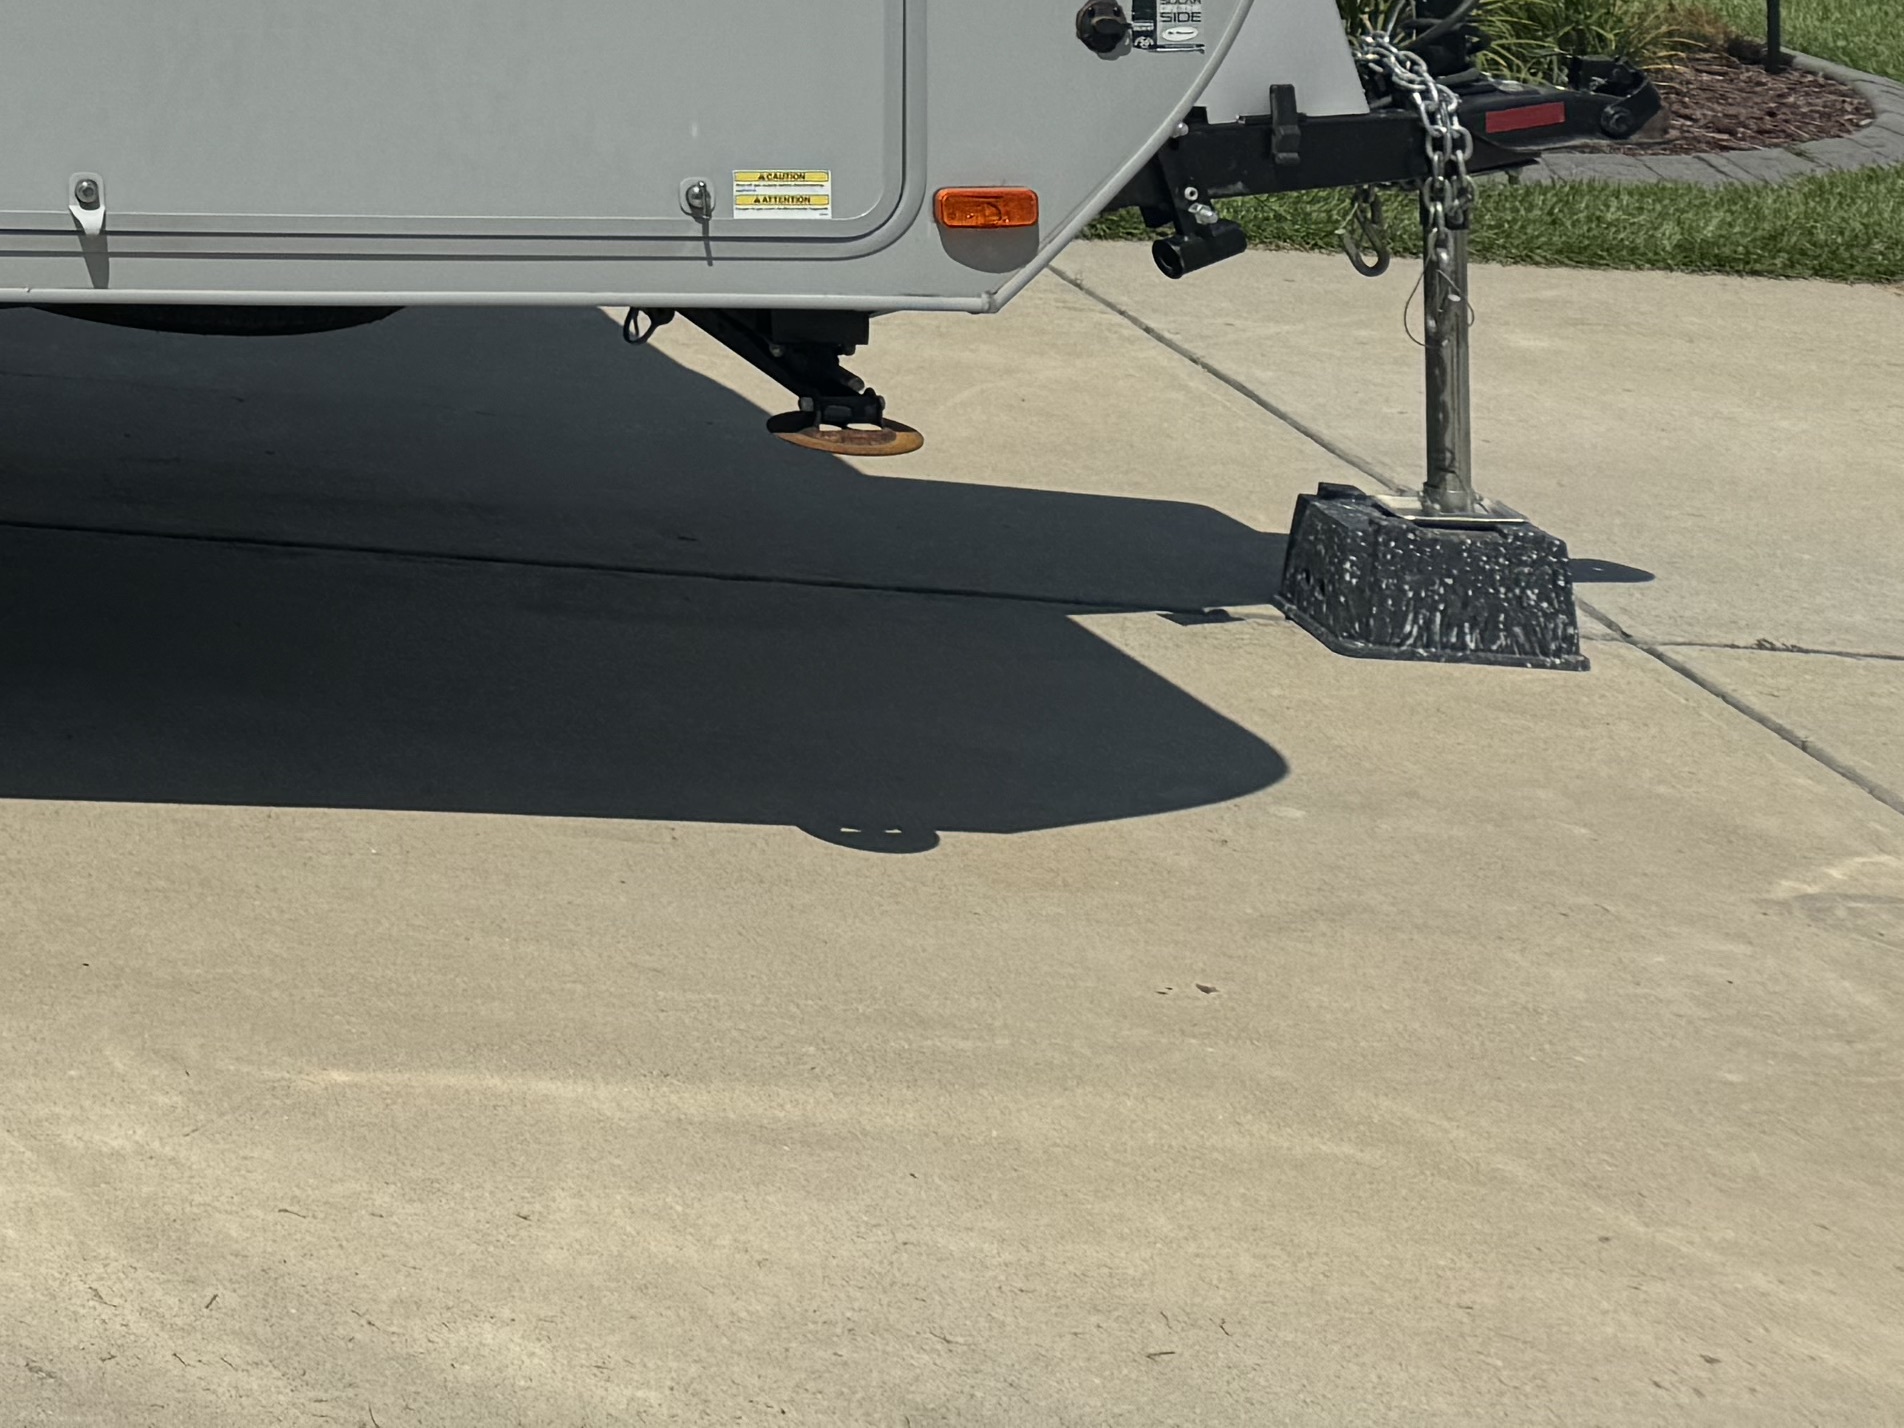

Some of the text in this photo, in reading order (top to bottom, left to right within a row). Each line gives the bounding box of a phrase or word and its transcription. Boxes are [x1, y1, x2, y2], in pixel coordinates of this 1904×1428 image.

[1159, 11, 1202, 23] SIDE
[766, 172, 806, 180] CAUTION
[762, 195, 811, 204] ATTENTION
